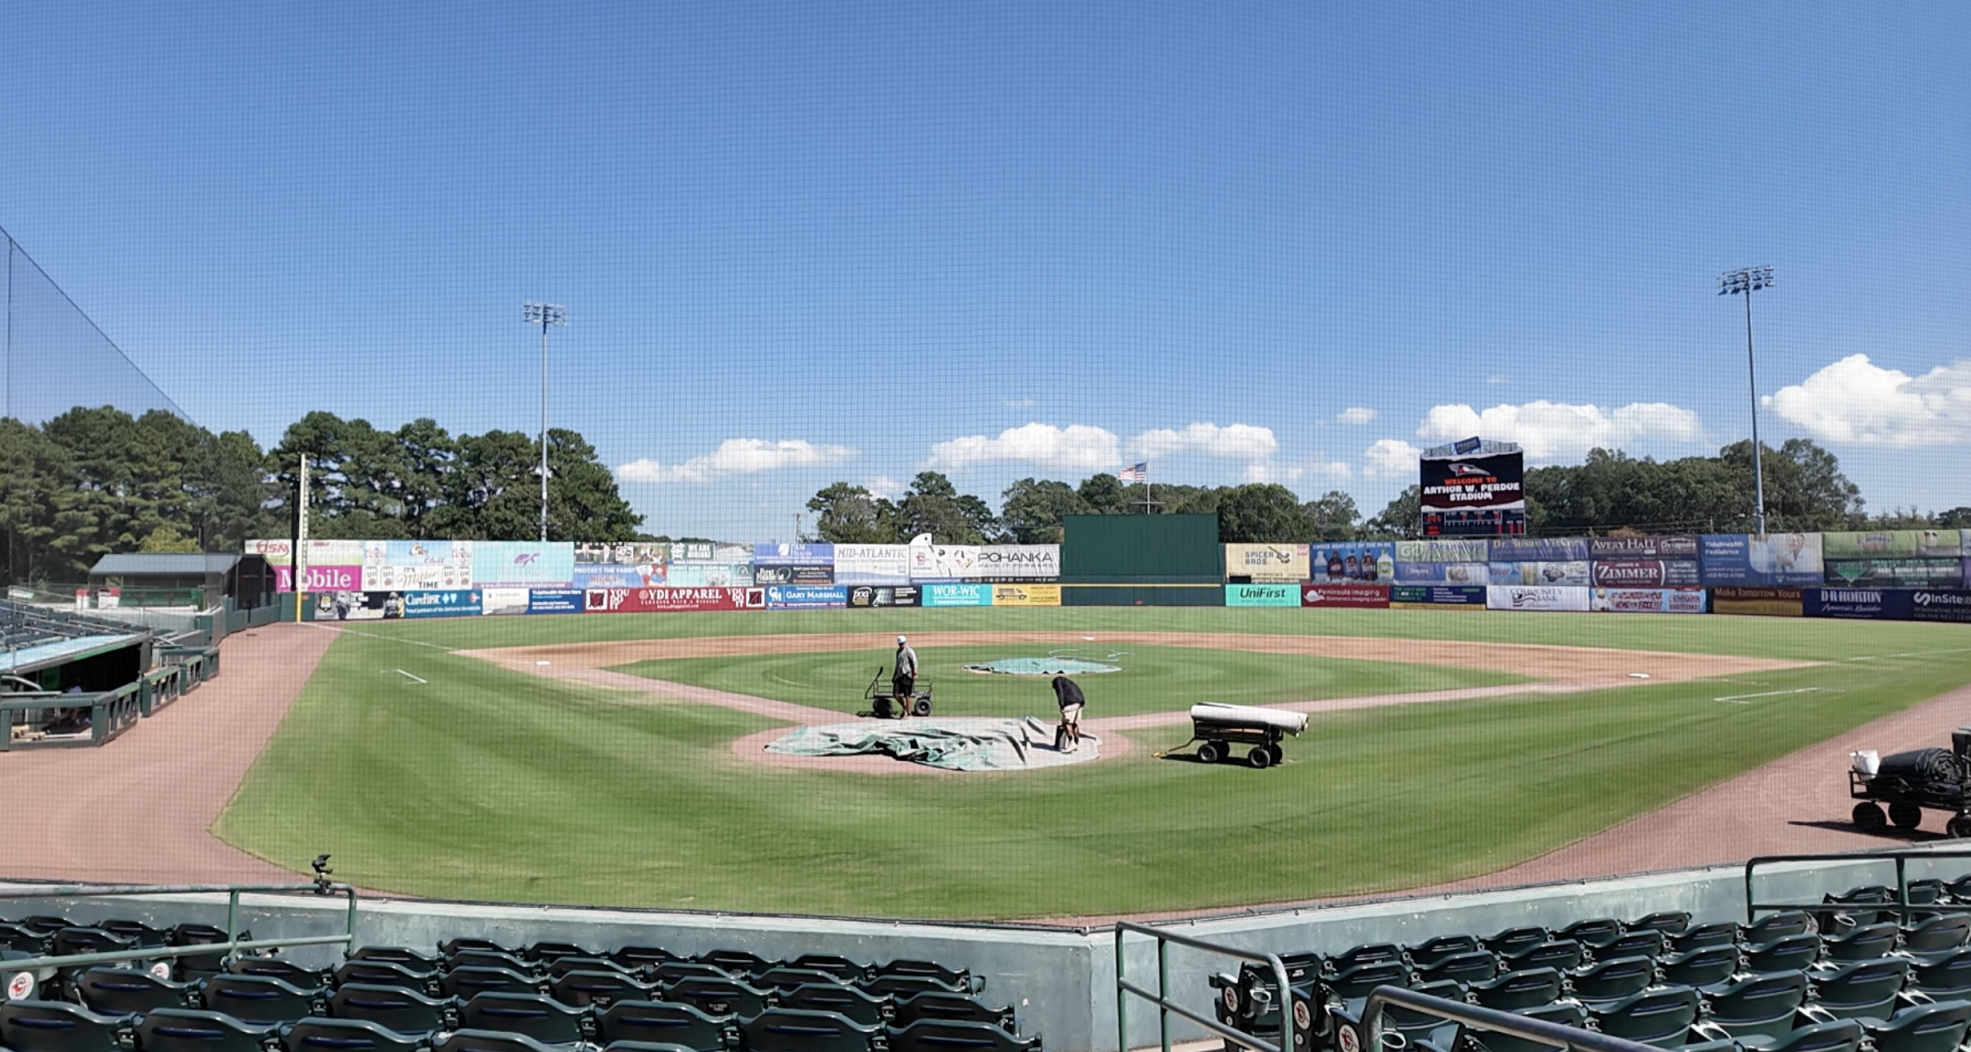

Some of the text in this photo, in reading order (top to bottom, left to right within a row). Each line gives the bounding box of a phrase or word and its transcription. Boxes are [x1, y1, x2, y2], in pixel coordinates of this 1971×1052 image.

[1444, 477, 1483, 485] WELCOME
[1423, 482, 1520, 495] ARTHUR W. PERDUE
[1449, 492, 1493, 501] STADIUM
[1592, 538, 1657, 550] AVERY HALL
[837, 548, 907, 558] MID-ATLANTIC
[978, 552, 1052, 563] POHANKA
[1598, 565, 1659, 579] ZIMMER
[610, 588, 629, 597] YOU
[649, 588, 722, 600] YDI APPAREL
[933, 585, 980, 597] WOR-WIC
[1240, 588, 1286, 598] UniFirst
[1510, 588, 1563, 596] COMMUNITY
[1715, 588, 1801, 598] Make Tomorrow Yours
[405, 593, 441, 605] CareFirst
[733, 594, 745, 602] DO
[1931, 593, 1963, 604] InSite
[610, 602, 619, 610] IT
